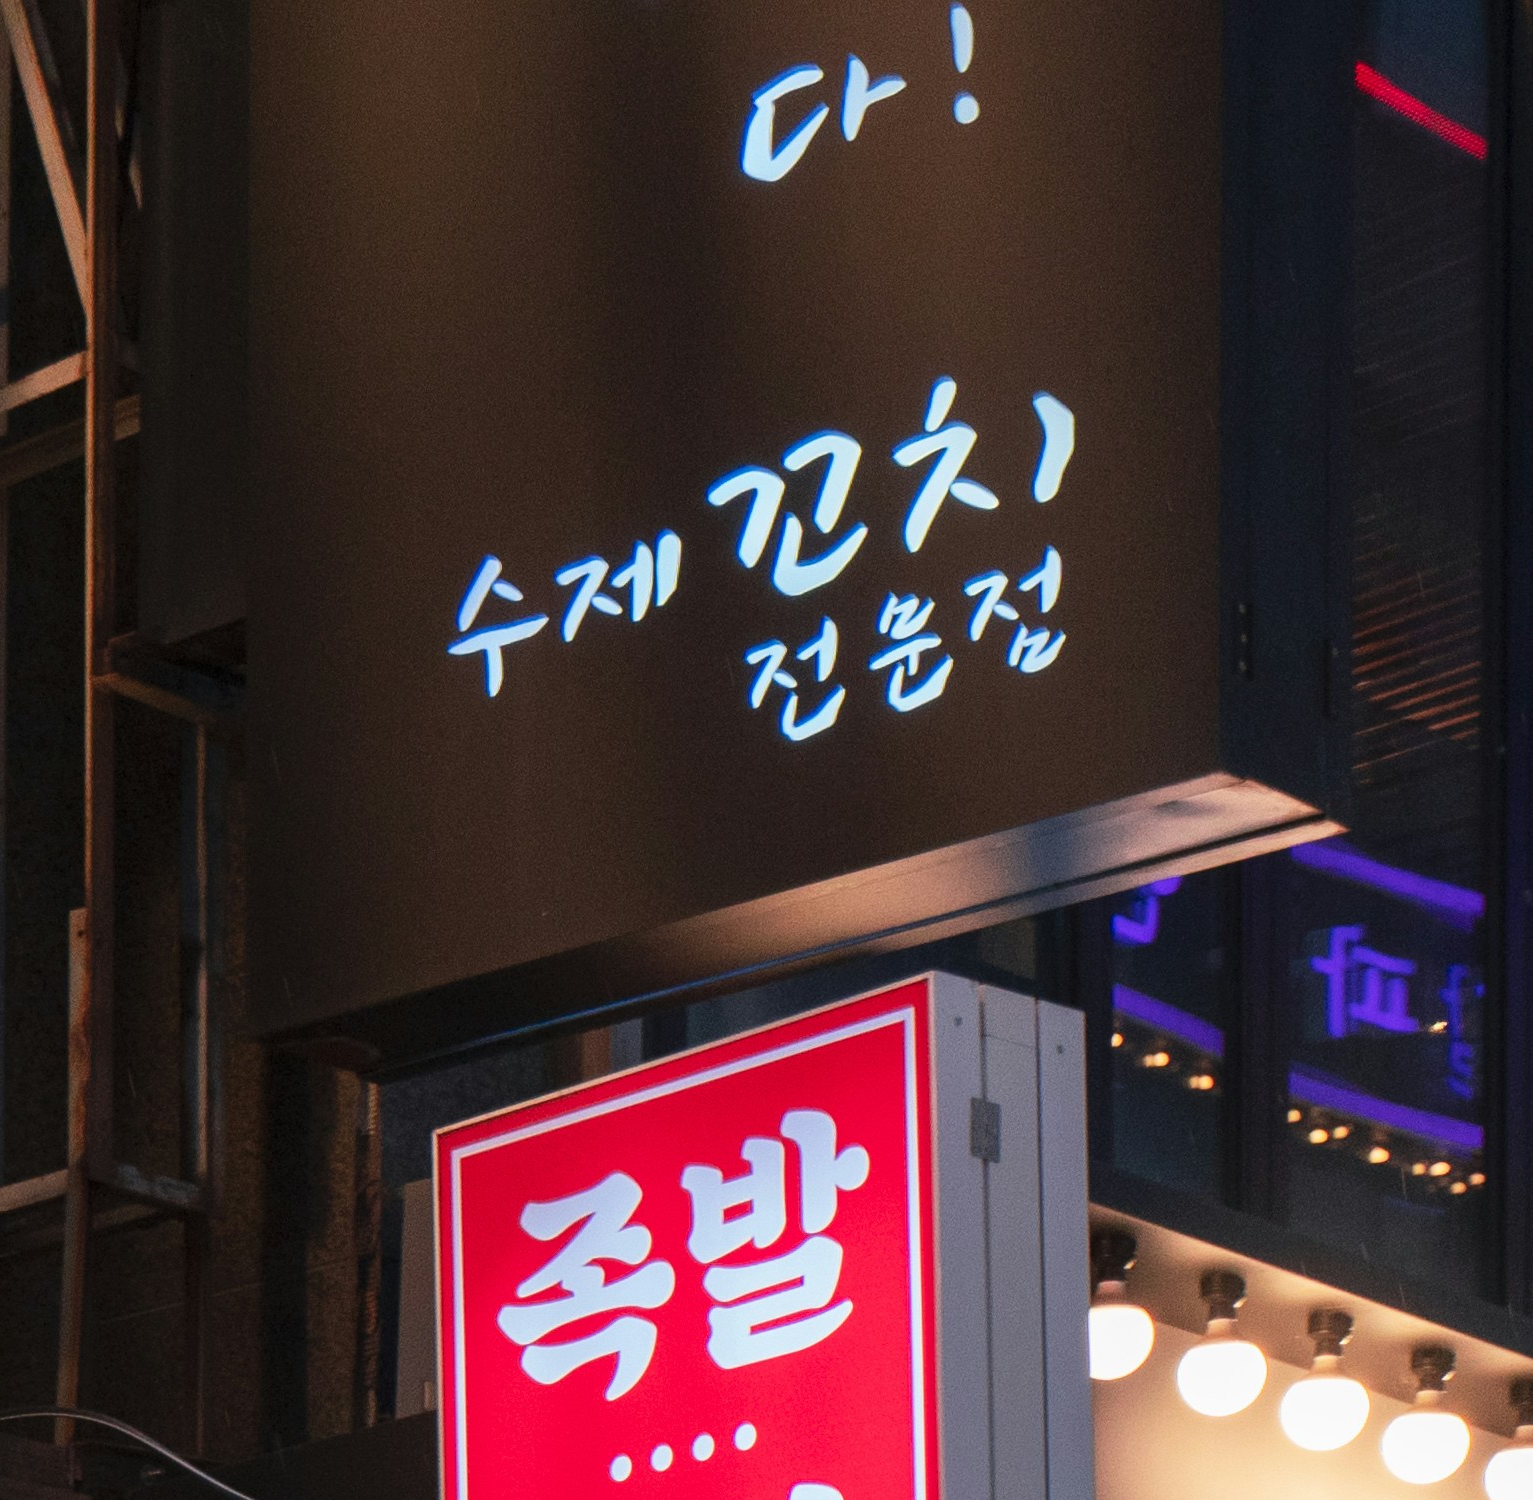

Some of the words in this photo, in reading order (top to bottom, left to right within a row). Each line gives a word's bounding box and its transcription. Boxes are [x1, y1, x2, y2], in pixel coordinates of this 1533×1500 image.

[741, 4, 980, 183] 다!
[448, 529, 682, 697] 수제
[708, 376, 1076, 597] 꼬치
[746, 546, 1065, 742] 전문점
[496, 1108, 871, 1401] 족발
